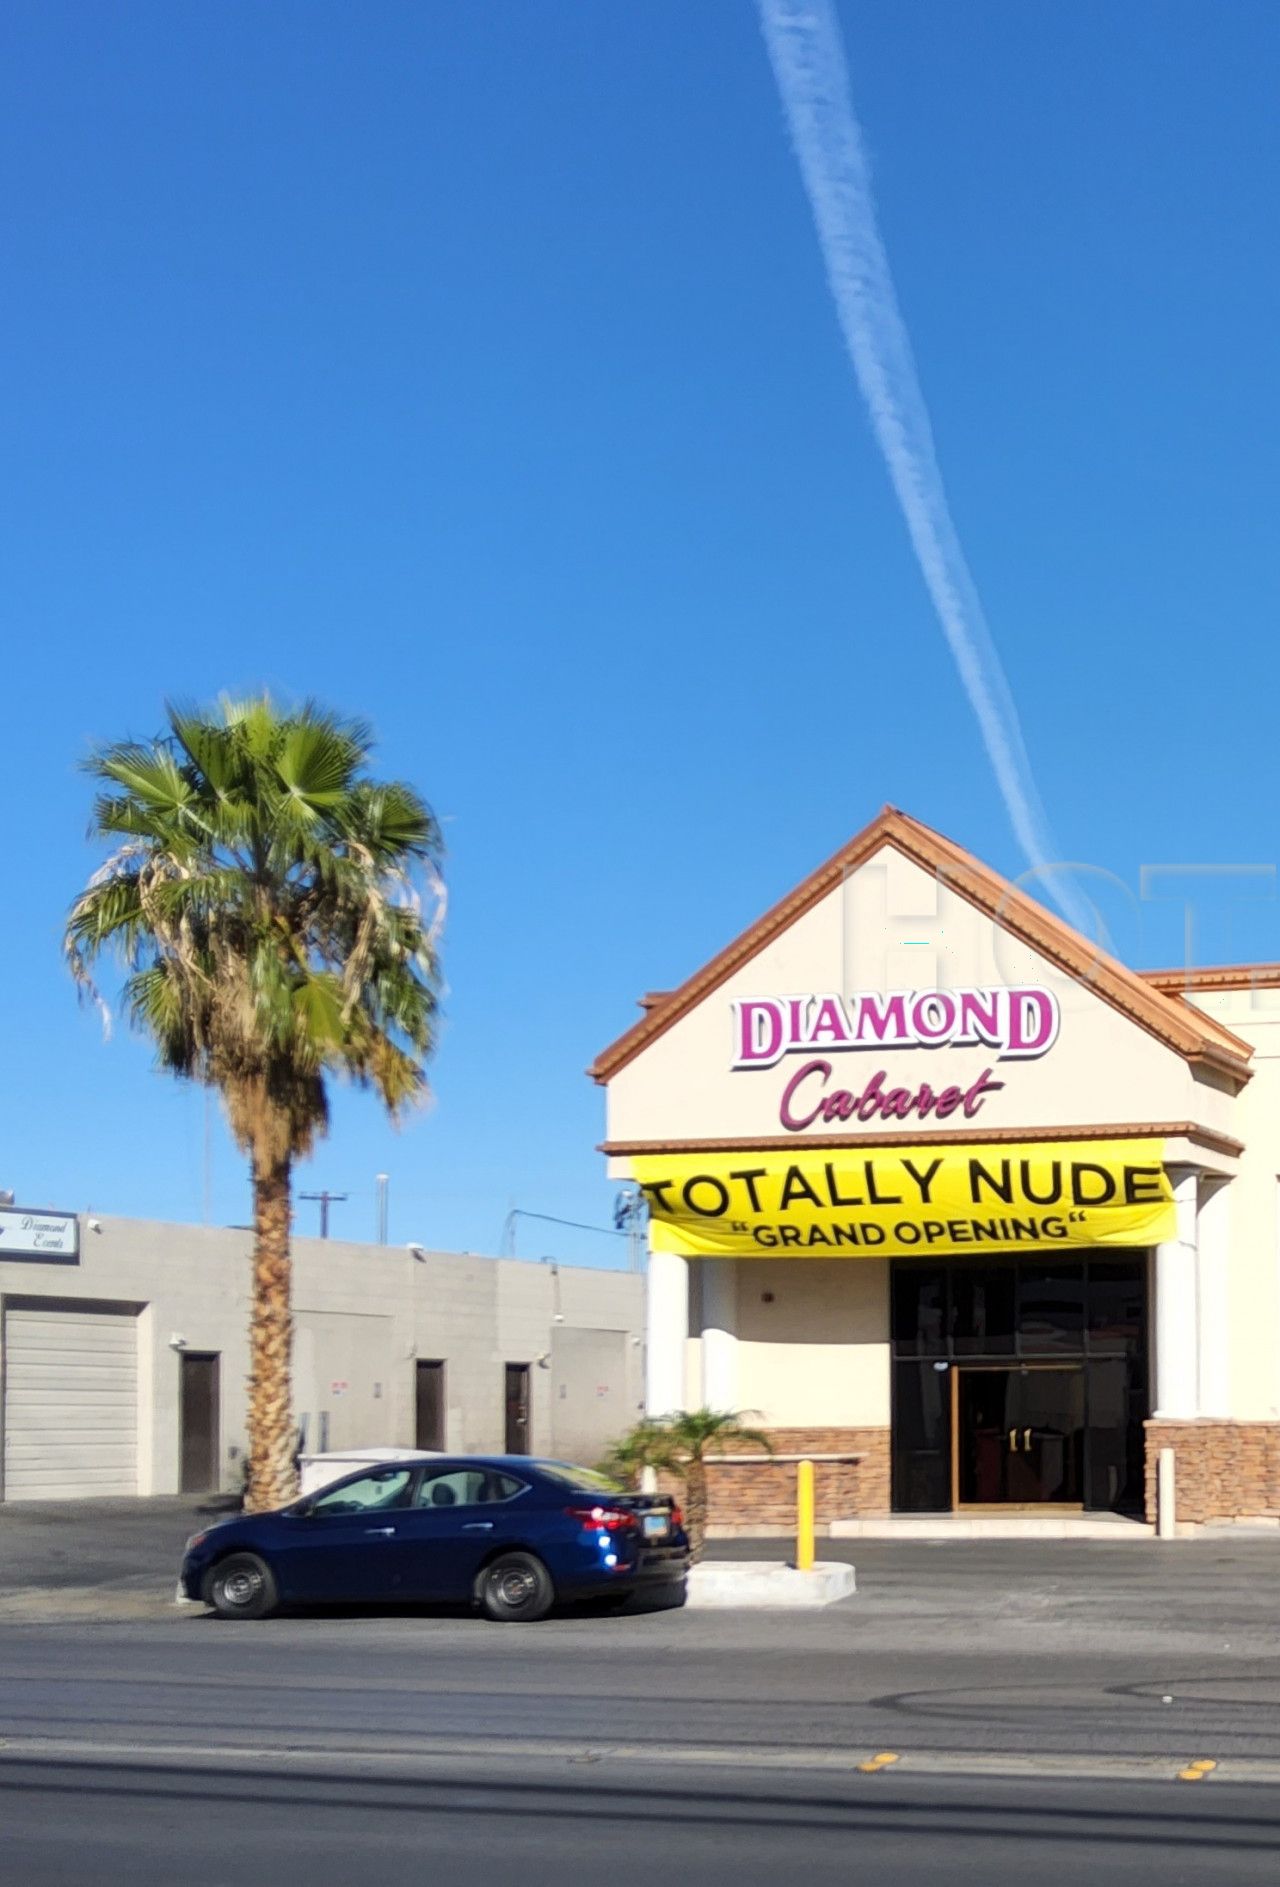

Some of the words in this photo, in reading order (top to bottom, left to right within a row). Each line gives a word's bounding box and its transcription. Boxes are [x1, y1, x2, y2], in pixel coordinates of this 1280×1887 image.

[733, 985, 1058, 1066] DIAMOND
[779, 1060, 1006, 1131] Cabaret
[642, 1159, 944, 1217] TOTALLY
[968, 1158, 1165, 1206] NUDE
